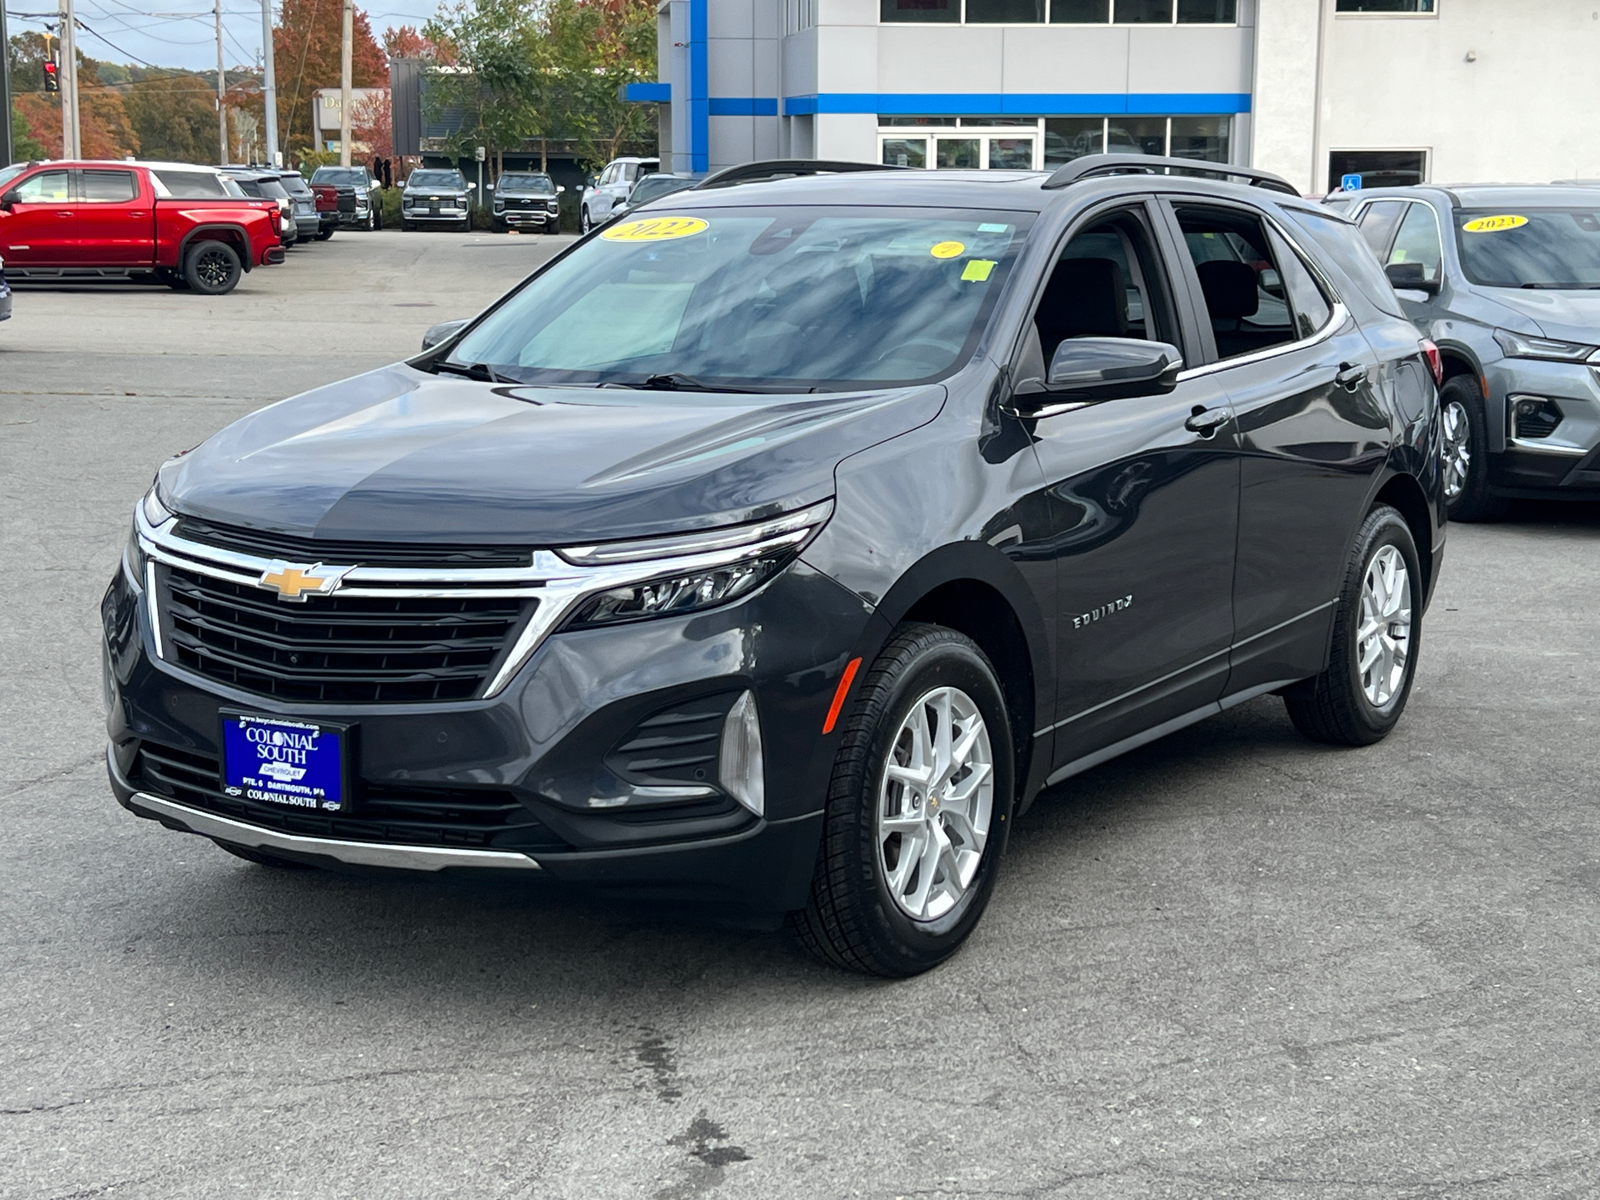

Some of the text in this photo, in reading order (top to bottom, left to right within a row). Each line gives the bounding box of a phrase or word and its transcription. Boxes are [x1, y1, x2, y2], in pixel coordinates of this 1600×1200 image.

[612, 221, 695, 238] 2022
[1476, 217, 1516, 231] 2023
[1072, 594, 1133, 629] EQUINOX
[245, 727, 319, 751] COLONIAL
[256, 743, 307, 765] SOUTH
[263, 765, 302, 777] CHEVROLET
[247, 789, 317, 809] COLONIAL SOUTH
